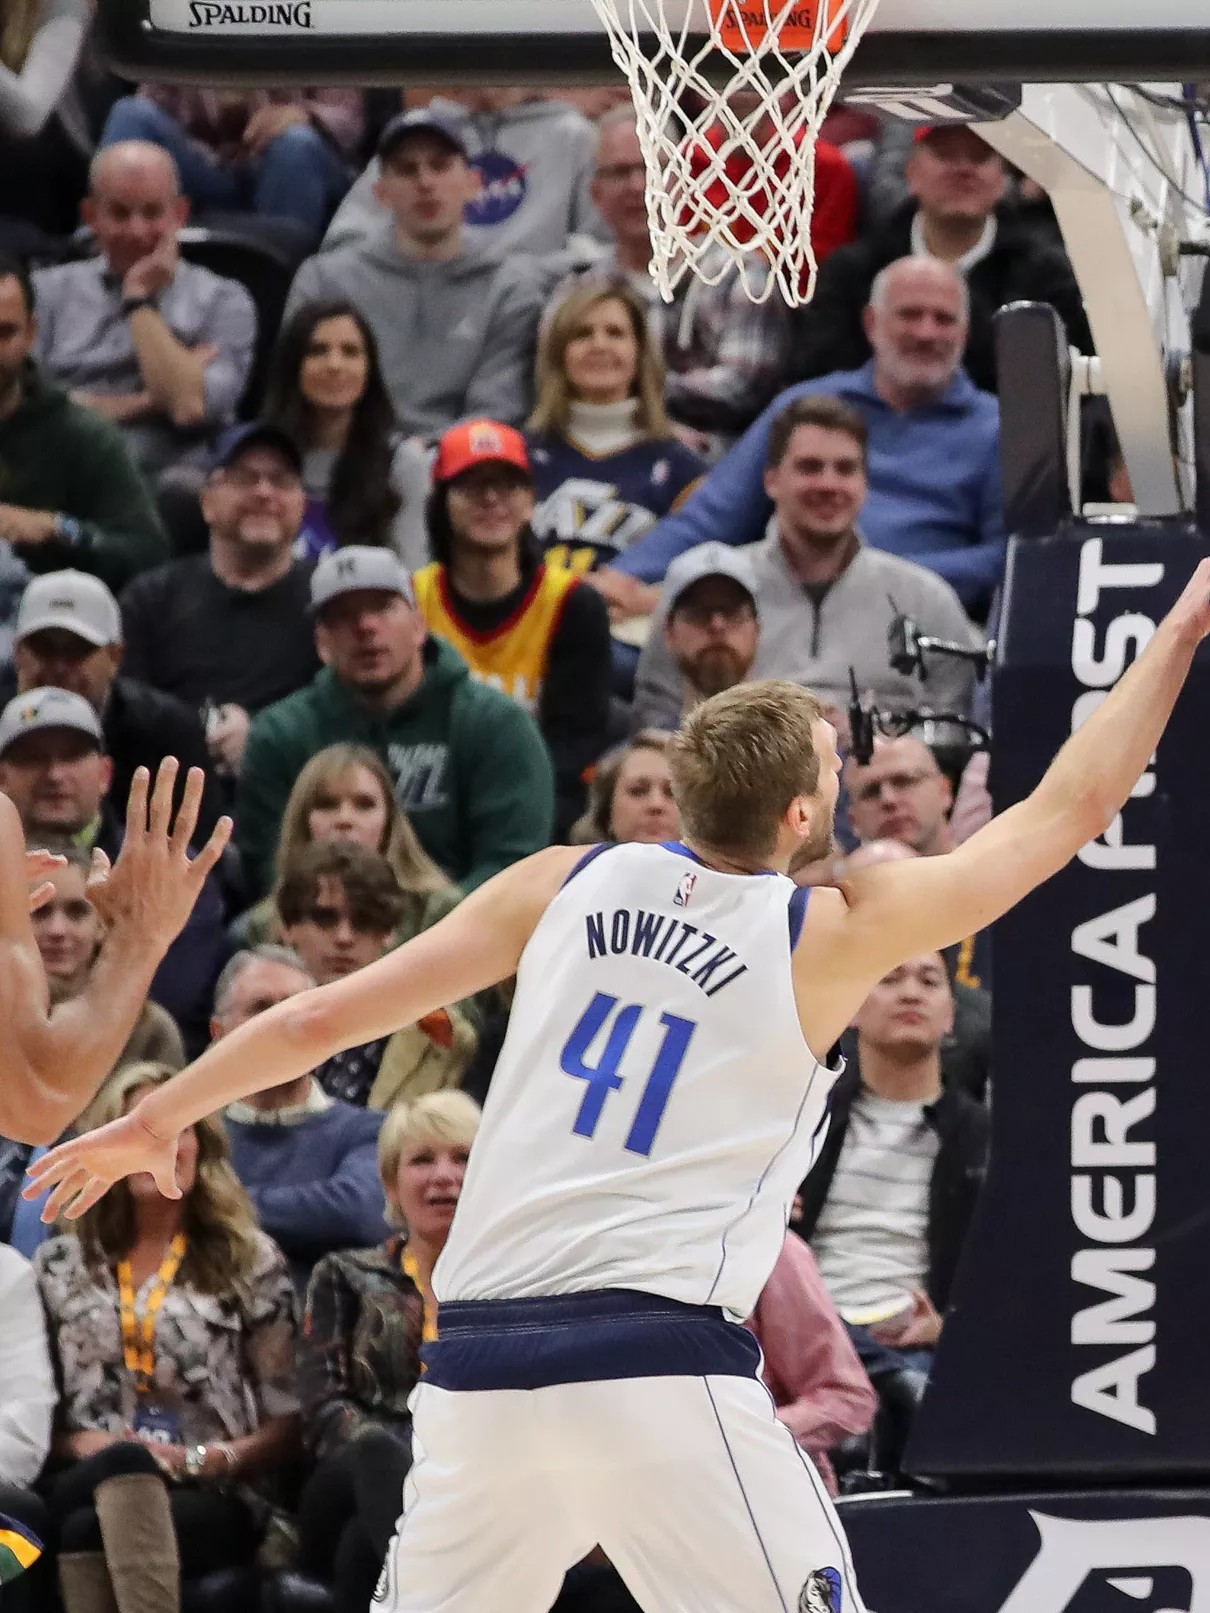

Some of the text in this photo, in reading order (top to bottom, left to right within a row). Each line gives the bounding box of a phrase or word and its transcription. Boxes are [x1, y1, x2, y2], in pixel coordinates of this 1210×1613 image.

[189, 1, 312, 28] SPALDING
[726, 9, 812, 29] SPALNG
[586, 908, 749, 998] NOWITZKI
[1071, 537, 1165, 1436] AMERICA FST
[559, 989, 699, 1158] 41
